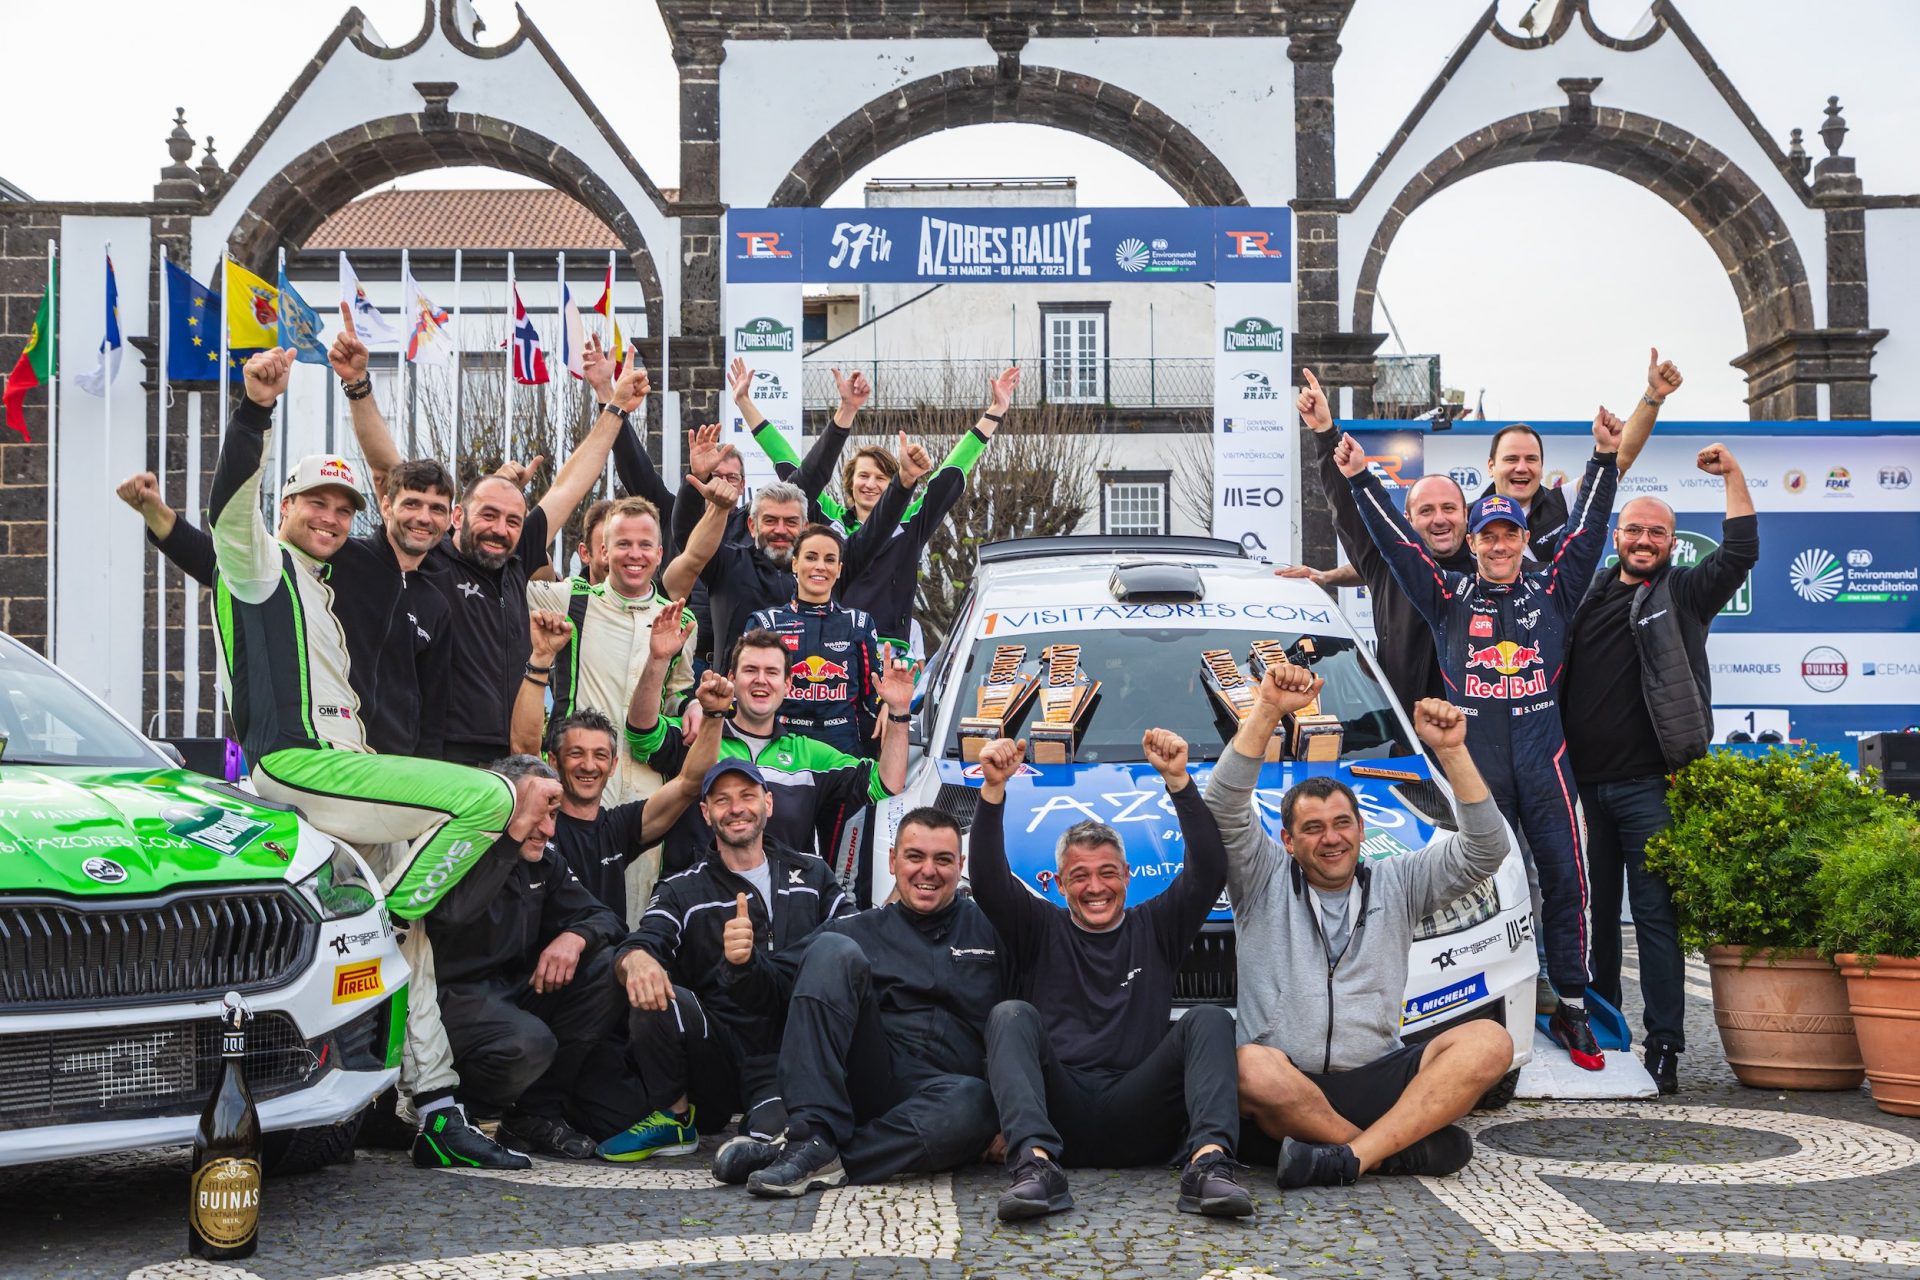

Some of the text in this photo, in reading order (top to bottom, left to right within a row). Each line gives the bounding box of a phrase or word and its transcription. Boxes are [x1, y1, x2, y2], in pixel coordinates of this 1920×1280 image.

[736, 232, 792, 256] TER
[828, 222, 893, 269] 57th
[917, 214, 1092, 276] AZORES RALLYE
[1226, 231, 1281, 255] TER
[1152, 251, 1196, 259] Environmental
[948, 265, 957, 275] 31
[960, 265, 991, 275] MARCH
[1001, 265, 1010, 275] 01
[1013, 265, 1038, 275] APRIL
[1041, 265, 1064, 275] 2023
[737, 330, 792, 350] AZORES RALLYE
[1226, 330, 1281, 350] AZORES RALLYE
[320, 469, 339, 477] Red
[1636, 485, 1668, 494] AÇORES
[1825, 479, 1851, 488] FPAK
[1848, 568, 1918, 580] Environmental
[1847, 580, 1918, 592] Accreditation
[984, 613, 998, 635] 1
[1474, 620, 1492, 629] SFR
[1709, 663, 1781, 674] RUPOMARQUES
[1806, 663, 1843, 675] QUINAS
[1464, 668, 1548, 699] Red Bull
[816, 682, 848, 701] Bull
[318, 705, 339, 716] OMP
[1532, 702, 1548, 712] LOEB
[791, 718, 814, 726] GODEY
[1744, 711, 1755, 734] 1
[337, 966, 379, 997] PIRELLI
[1422, 983, 1477, 1012] MICHELIN
[200, 1188, 259, 1209] QUINAS
